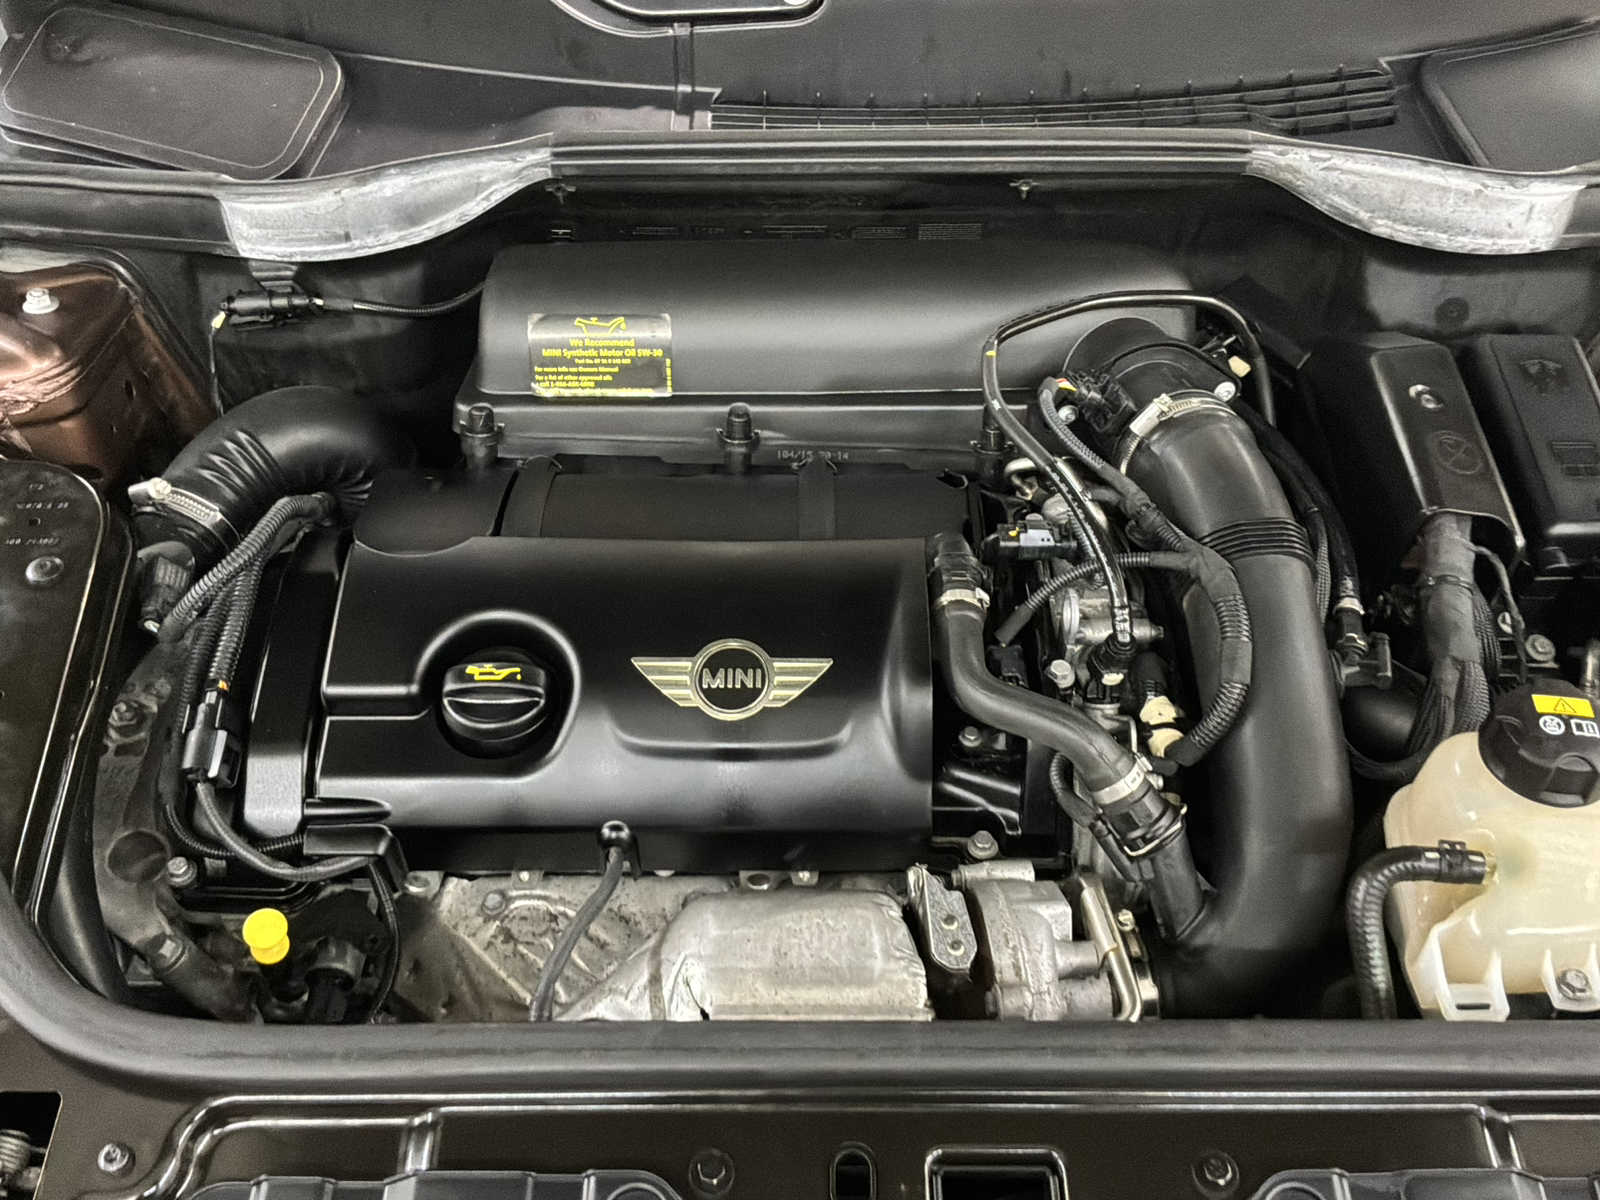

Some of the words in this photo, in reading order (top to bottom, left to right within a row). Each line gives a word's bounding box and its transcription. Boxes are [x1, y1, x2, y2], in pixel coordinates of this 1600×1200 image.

[569, 338, 583, 347] We
[585, 338, 635, 347] Recommend
[542, 348, 562, 357] MINI
[563, 348, 598, 359] Synthetic
[599, 348, 624, 357] Motor
[624, 348, 636, 357] Oil
[637, 348, 663, 357] 5W-30
[579, 374, 603, 382] approved
[702, 668, 762, 689] MINI
